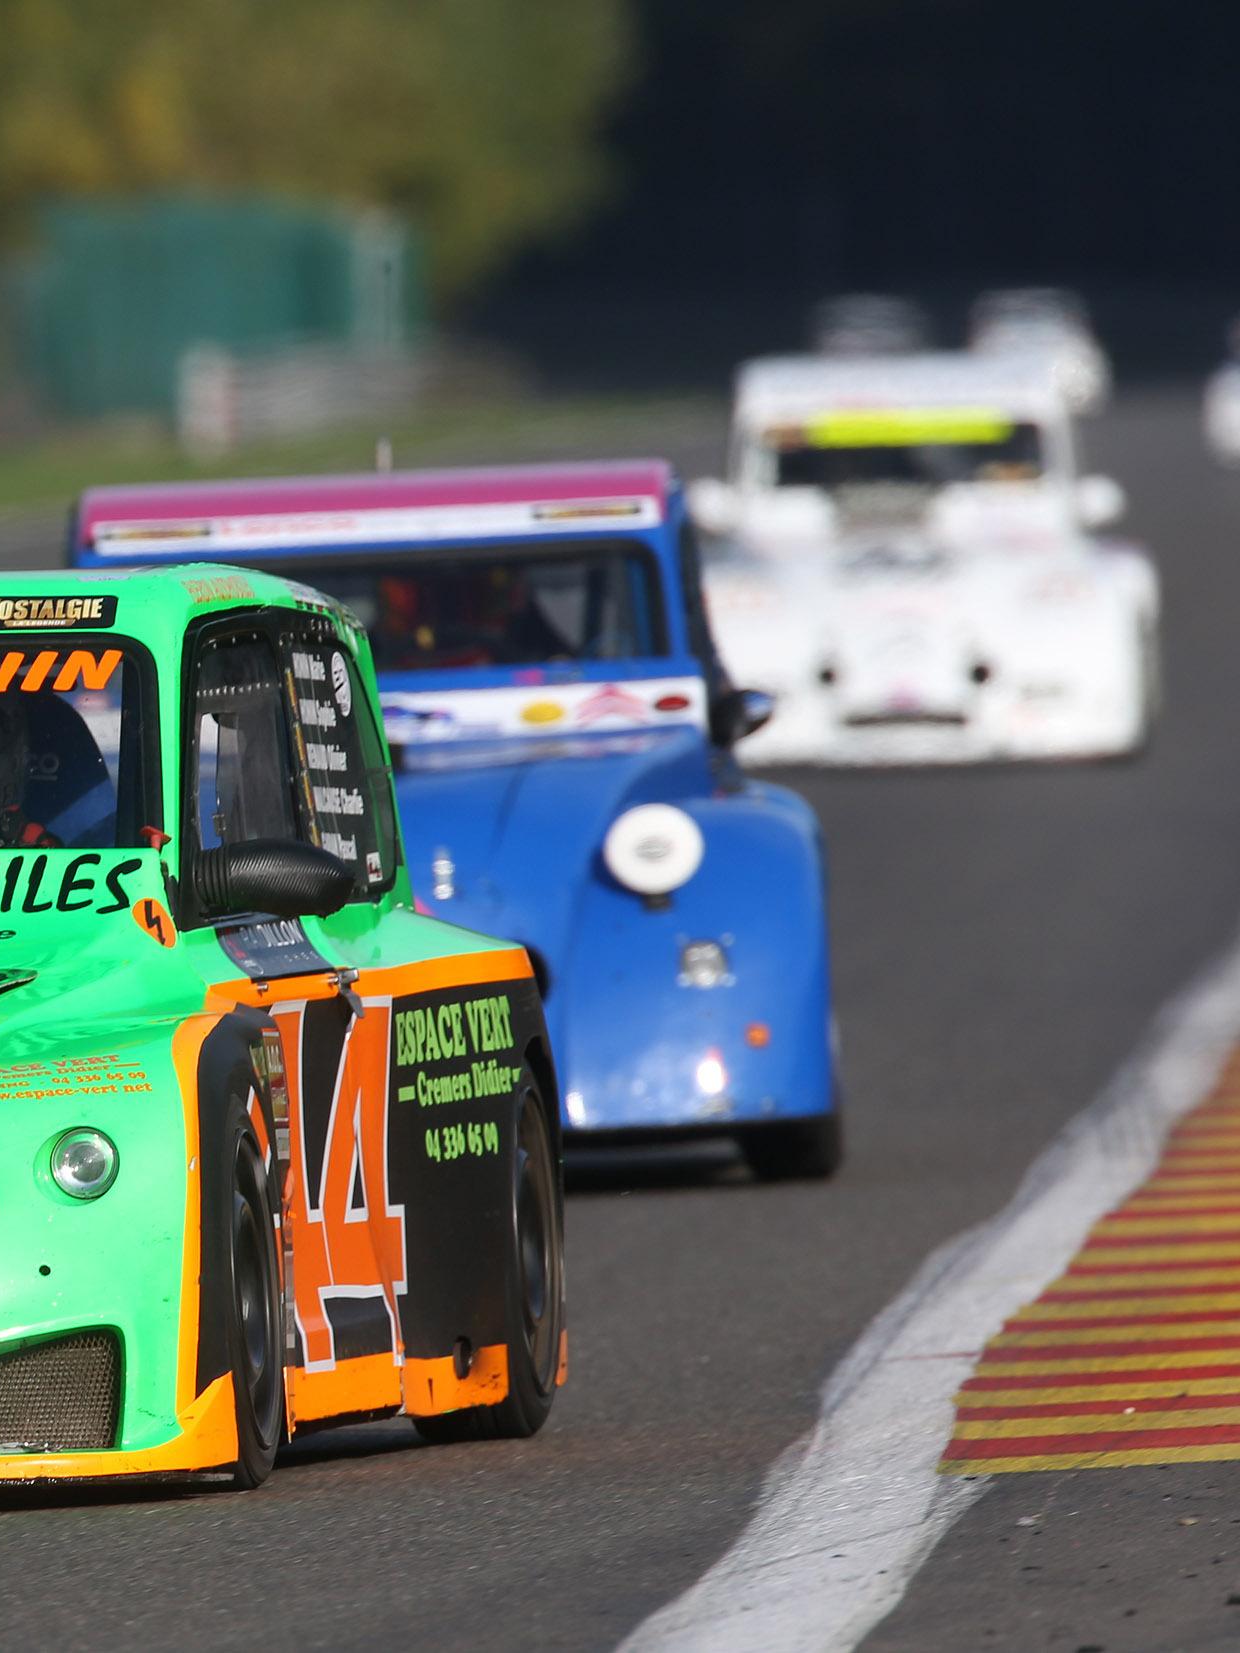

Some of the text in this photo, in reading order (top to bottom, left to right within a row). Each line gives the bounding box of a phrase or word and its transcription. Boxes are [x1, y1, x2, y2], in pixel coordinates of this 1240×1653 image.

[395, 995, 514, 1066] ESPACE VERT
[417, 1058, 513, 1107] Cremers Didier
[425, 1120, 500, 1163] 04 336 65 09
